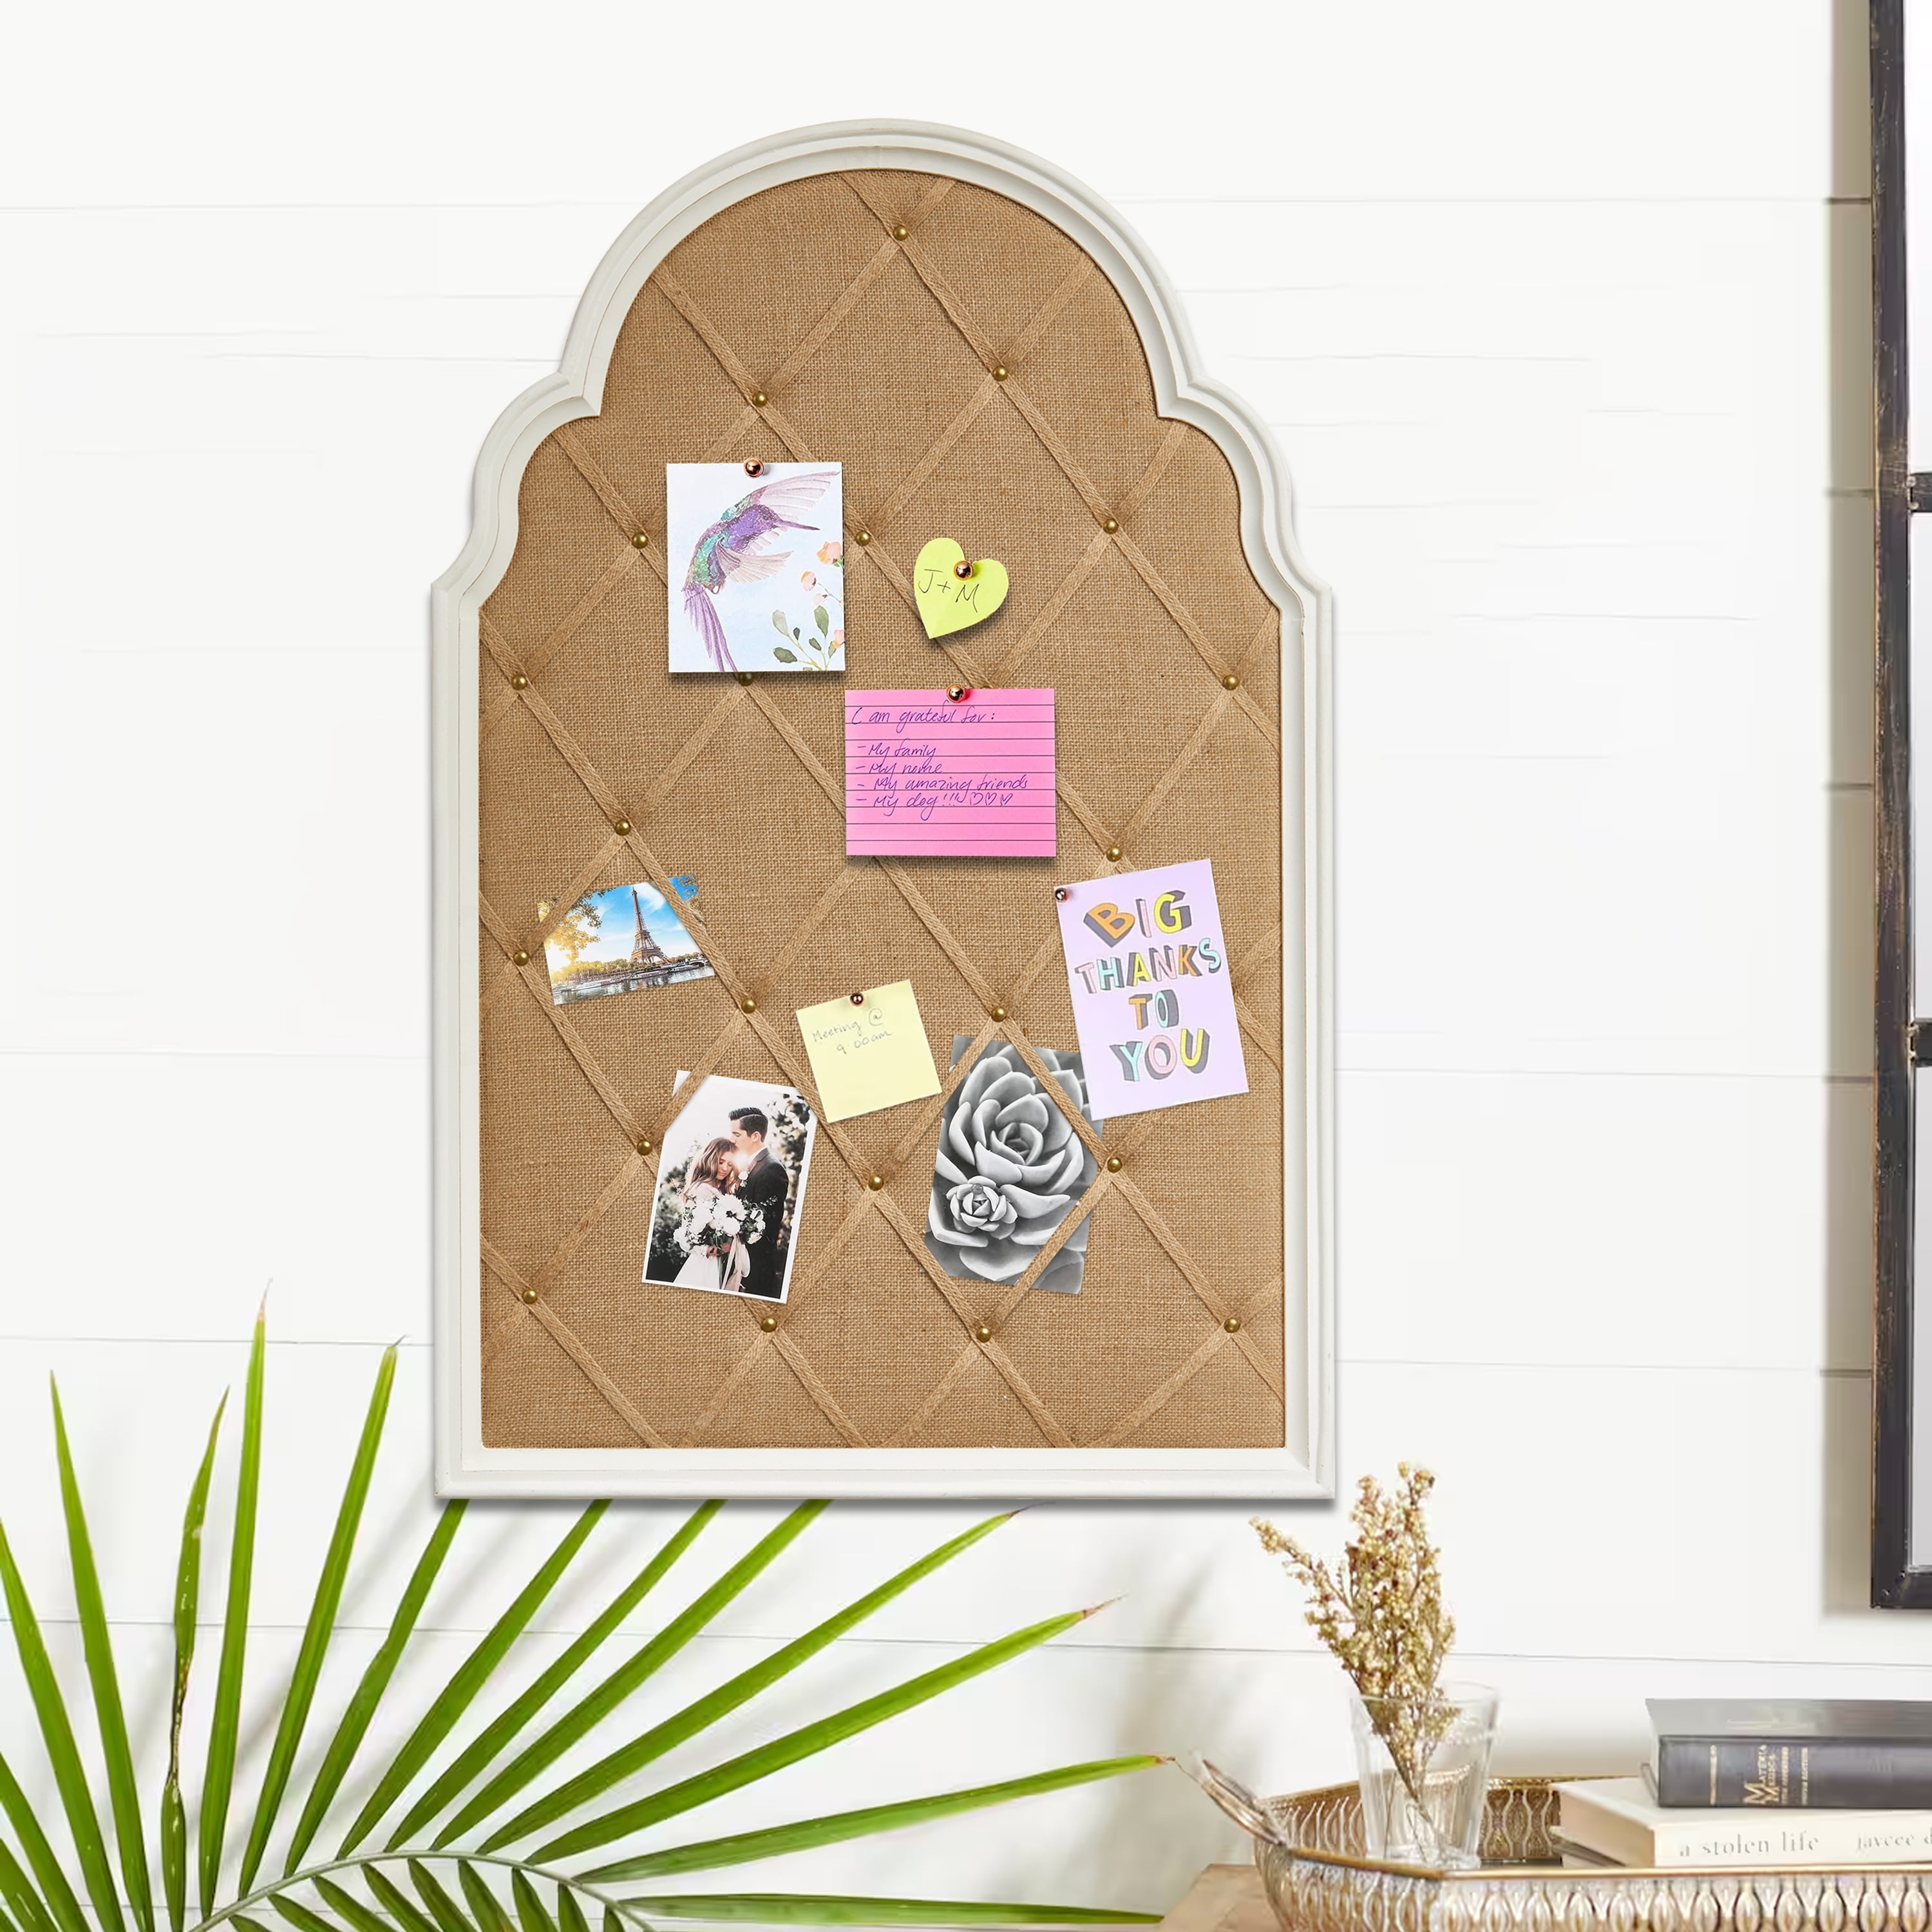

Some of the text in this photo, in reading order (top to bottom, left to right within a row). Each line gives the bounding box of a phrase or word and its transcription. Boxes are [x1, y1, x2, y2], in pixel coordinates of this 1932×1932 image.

[869, 712, 890, 723] am
[896, 699, 956, 734] grateful
[894, 737, 936, 769] family
[905, 775, 972, 803] amazing
[977, 773, 1028, 791] friends
[1083, 889, 1192, 948] BIG
[1075, 938, 1222, 994] THANKS
[813, 1007, 885, 1043] Meeting @
[1128, 989, 1179, 1030] TO
[1110, 1028, 1210, 1082] YOU
[1702, 1833, 1770, 1856] stolen
[1782, 1830, 1819, 1852] life
